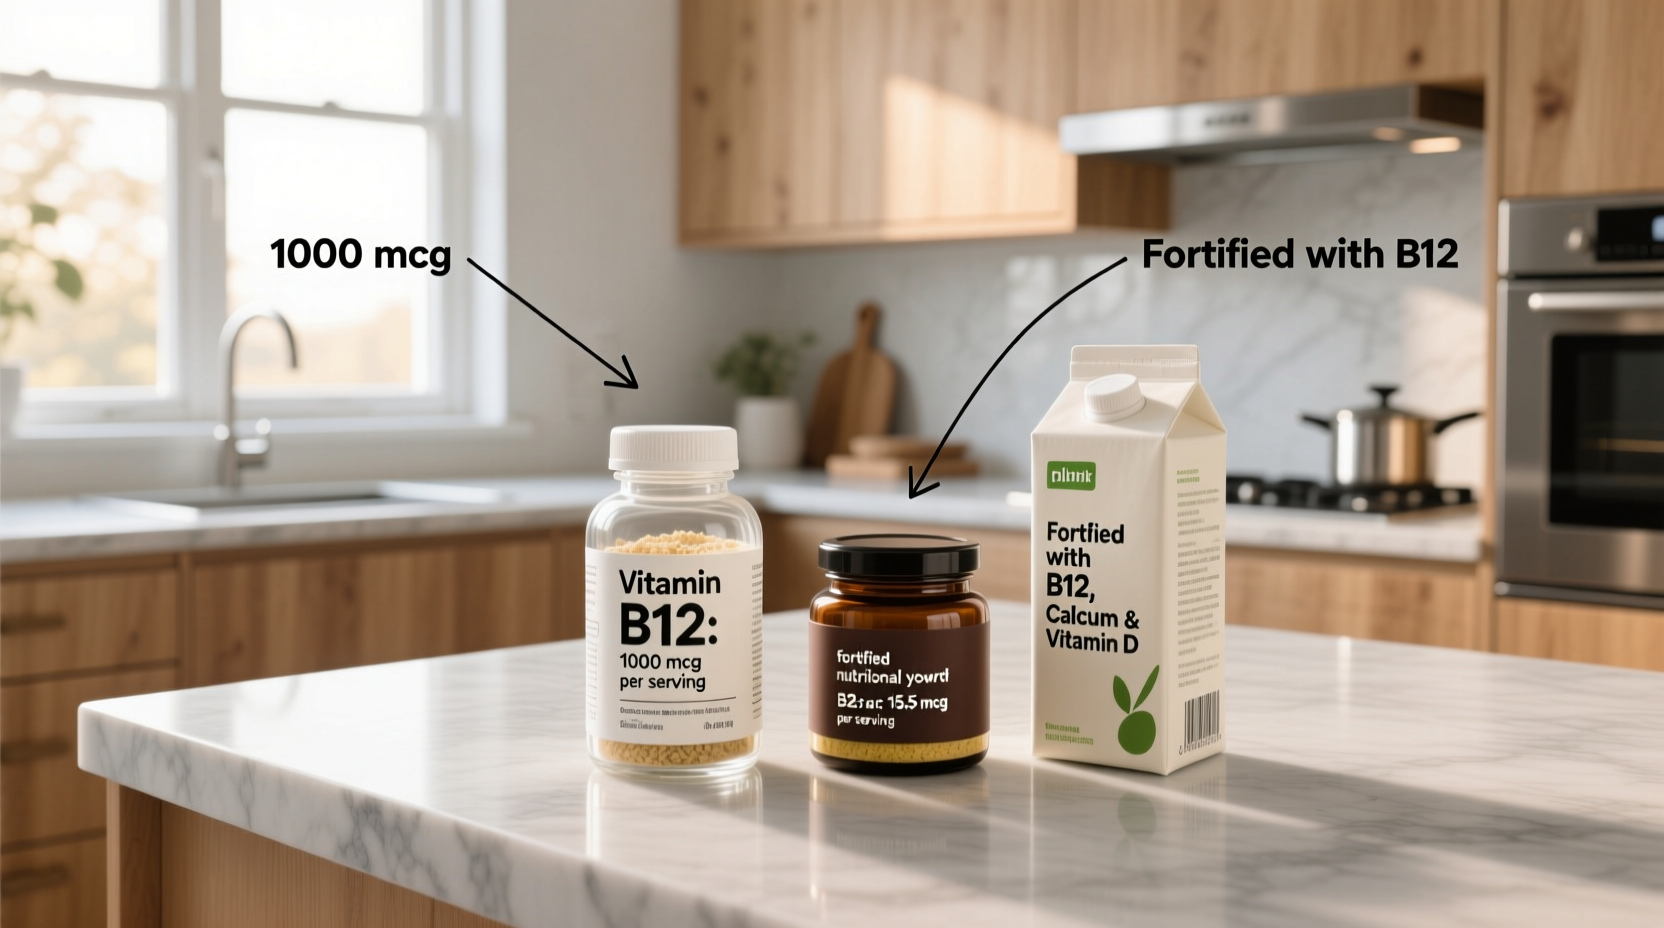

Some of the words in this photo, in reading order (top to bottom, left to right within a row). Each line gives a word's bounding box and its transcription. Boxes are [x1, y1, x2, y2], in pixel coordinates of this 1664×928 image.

[1045, 546, 1091, 568] with
[618, 568, 721, 596] Vitamin
[1046, 572, 1096, 604] B12,
[620, 602, 718, 647] B12:
[1045, 603, 1119, 628] Calcum
[1123, 609, 1140, 630] &
[1045, 628, 1118, 653] Vitamin
[1123, 633, 1139, 654] D
[619, 652, 662, 670] 1000
[666, 656, 702, 673] mcg
[620, 675, 644, 692] per
[647, 672, 706, 693] serving
[920, 697, 949, 713] mcg
